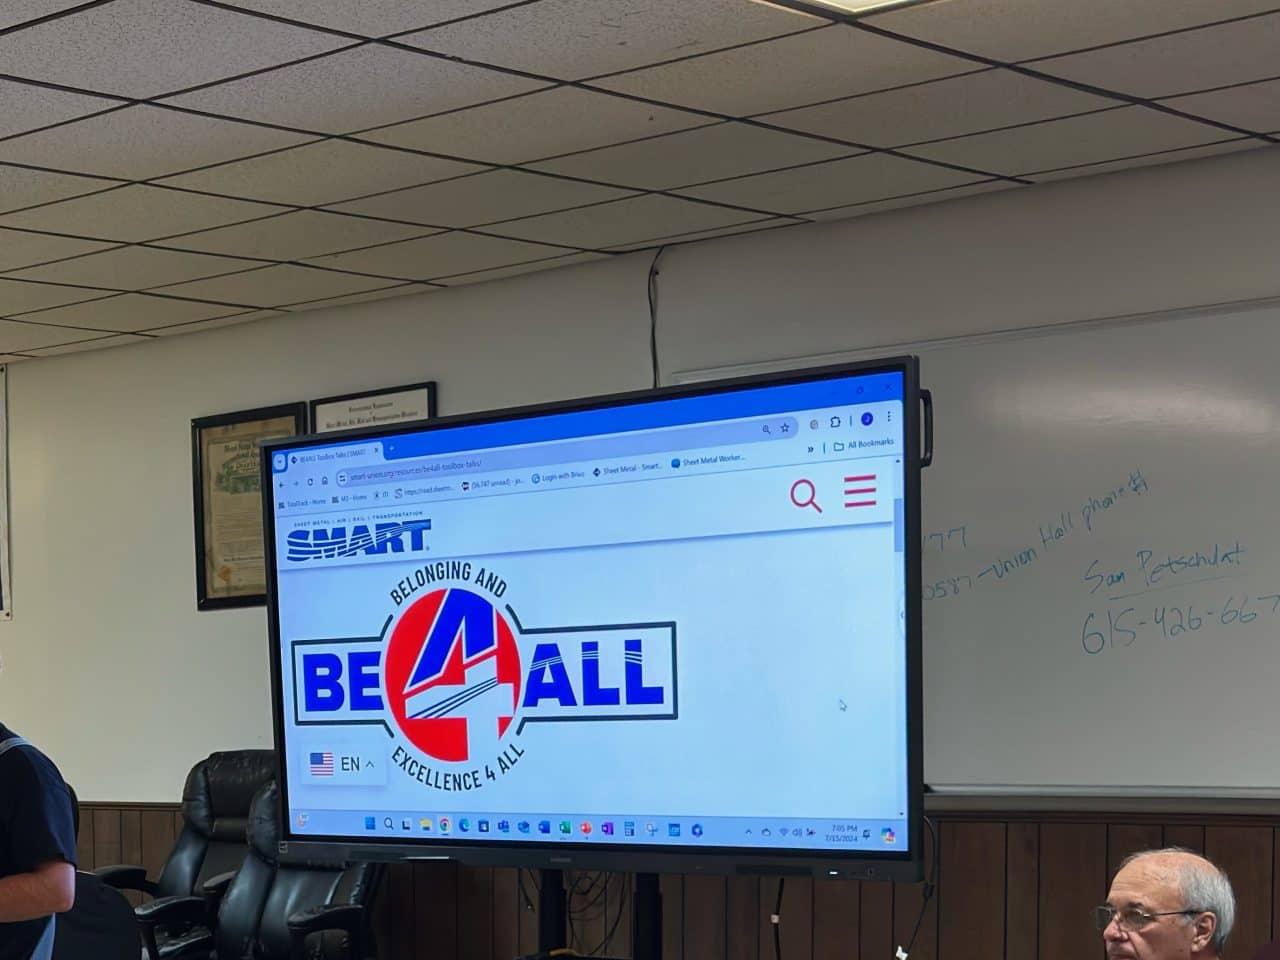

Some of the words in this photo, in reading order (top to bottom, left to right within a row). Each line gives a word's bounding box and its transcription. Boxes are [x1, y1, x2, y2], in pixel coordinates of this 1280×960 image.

[848, 440, 857, 450] All
[858, 436, 895, 448] Bookmarks
[286, 518, 432, 562] SMART
[1039, 511, 1073, 552] Hall
[390, 560, 471, 606] BELONGING
[475, 567, 507, 598] AND
[303, 651, 384, 712] BE
[522, 638, 664, 708] ALL
[341, 756, 361, 772] EN
[391, 745, 481, 791] EXCELLENCE
[485, 765, 496, 782] 4
[497, 744, 525, 774] ALL
[846, 823, 858, 833] PM
